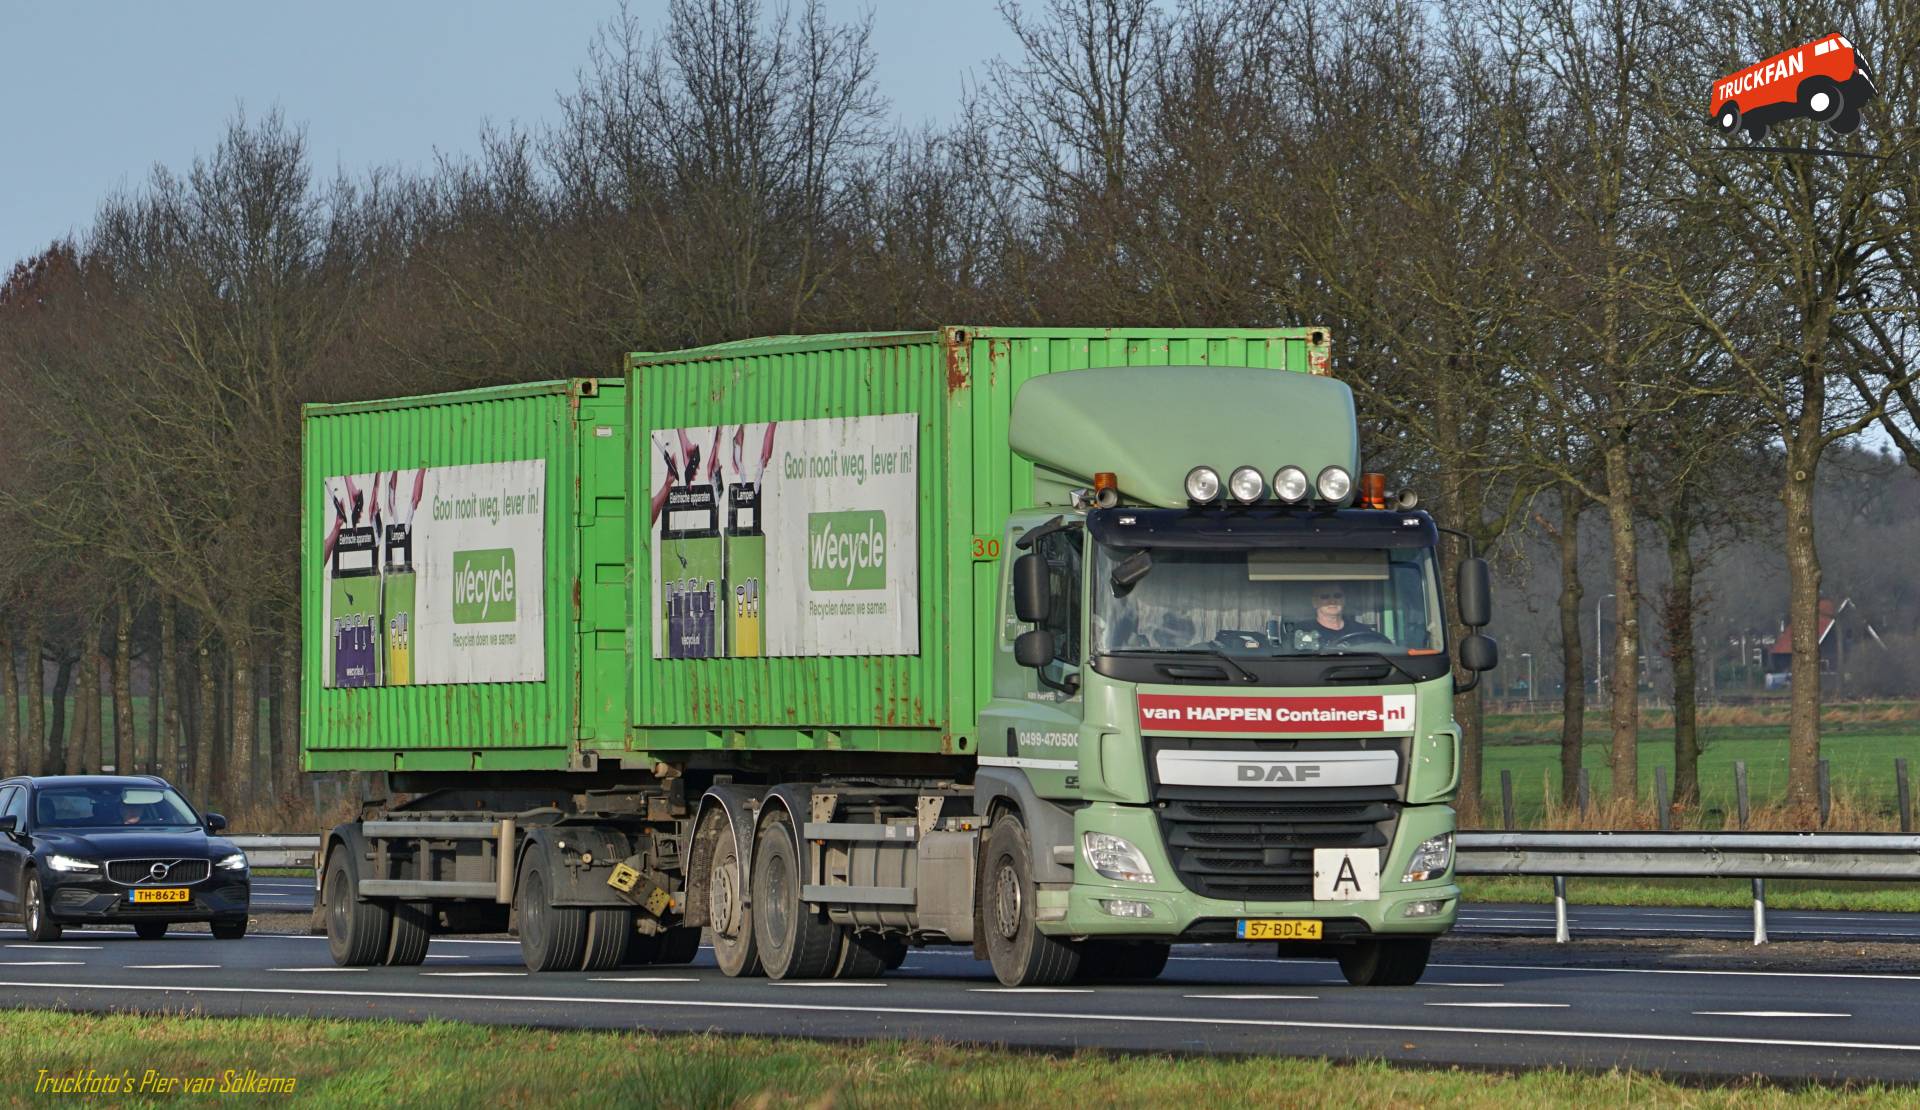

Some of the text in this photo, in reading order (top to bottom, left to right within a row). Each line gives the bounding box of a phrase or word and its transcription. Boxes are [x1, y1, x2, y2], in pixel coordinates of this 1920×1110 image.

[784, 445, 912, 485] Gooi nooit weg, lever in!
[433, 488, 539, 526] Gooi nooit weg, lever in!
[811, 518, 883, 588] wecycle
[973, 539, 1000, 558] 30
[455, 556, 513, 619] wecycle
[809, 600, 887, 617] Recyclen doen we samen
[452, 632, 516, 650] Recyclen doen we samen
[1142, 706, 1406, 722] van HAPPEN Containers.nl
[1237, 765, 1320, 782] DAF
[1333, 857, 1361, 892] A
[138, 890, 186, 901] TH-862-B
